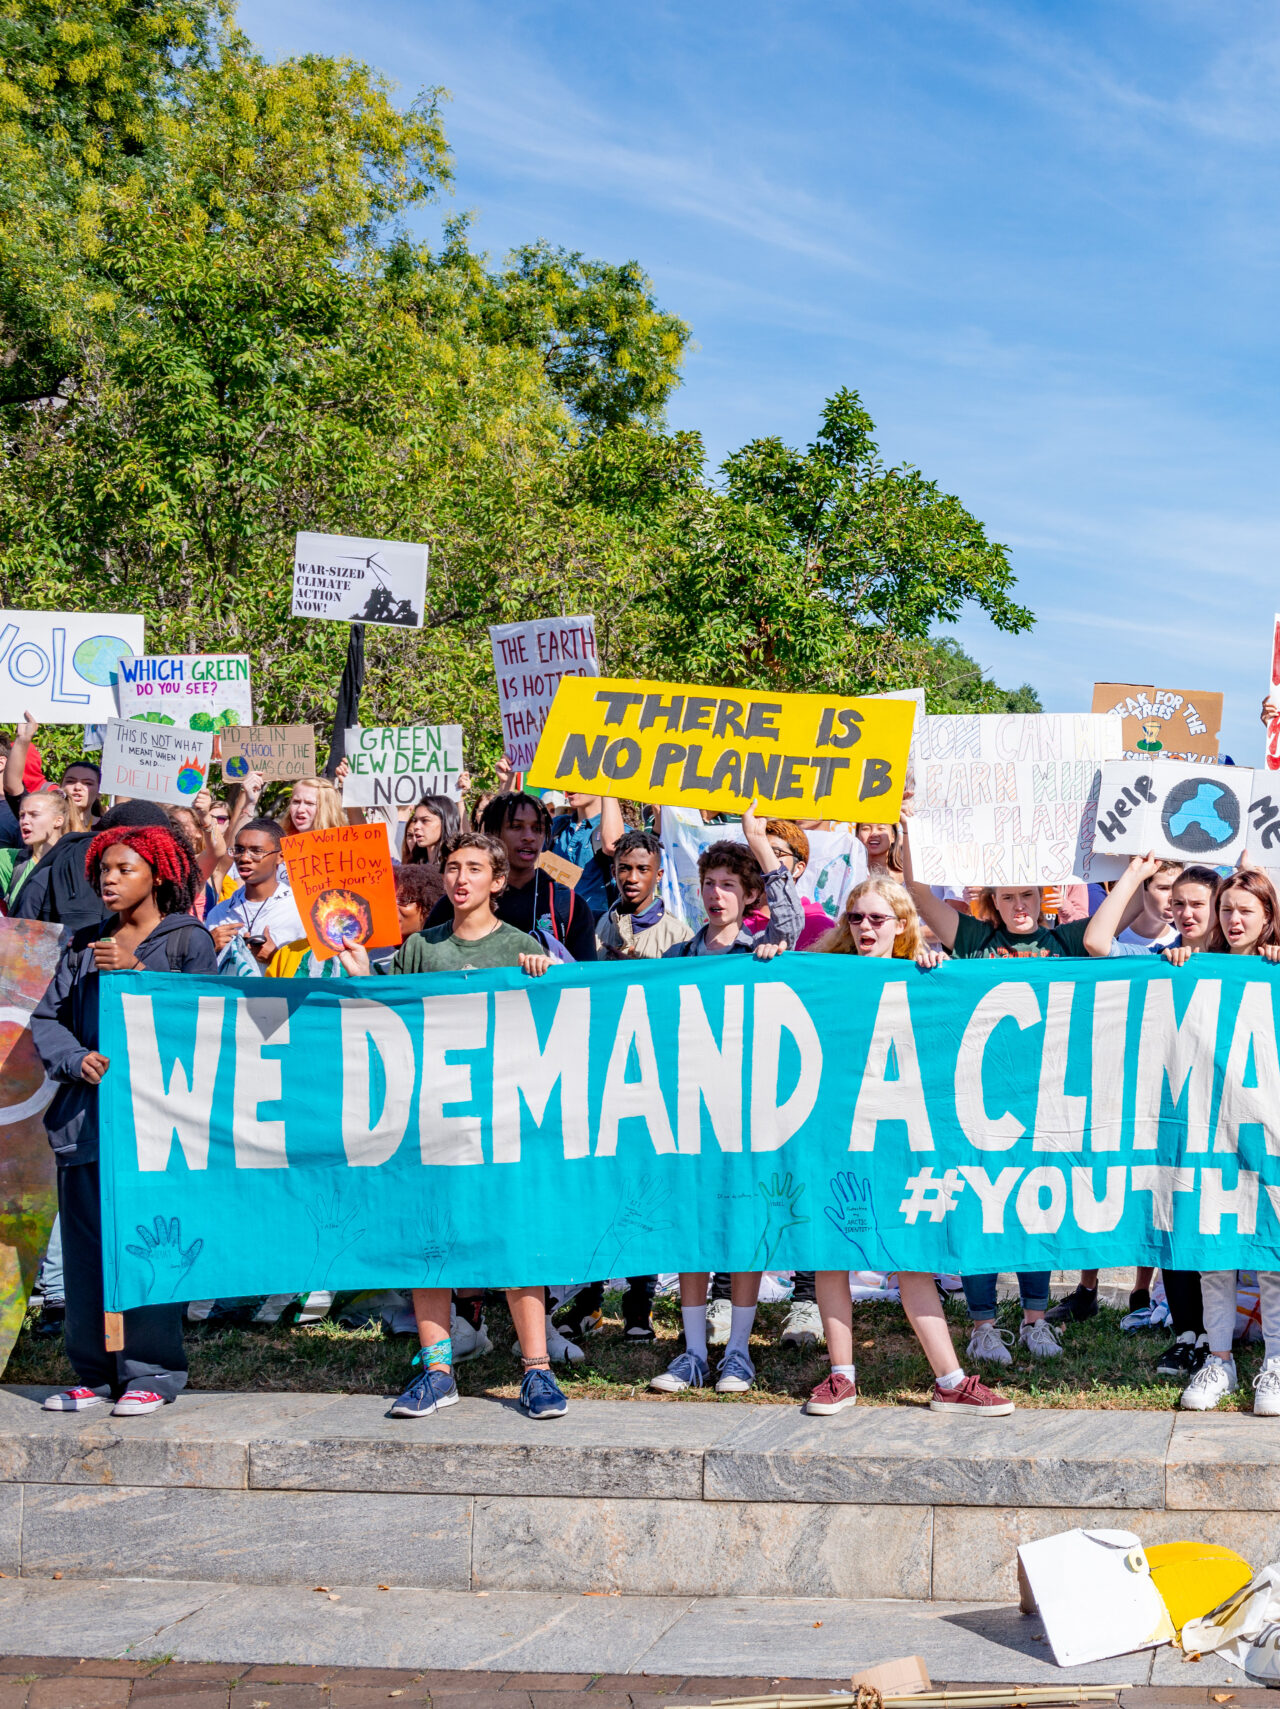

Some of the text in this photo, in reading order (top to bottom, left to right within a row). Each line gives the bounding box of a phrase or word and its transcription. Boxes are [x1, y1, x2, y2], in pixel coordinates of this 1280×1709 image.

[296, 576, 351, 591] CLIMATE
[297, 563, 365, 579] WAR-SIZED
[295, 588, 342, 602] ACTION
[295, 600, 327, 613] NOW!
[497, 627, 596, 665] THE EARTH
[120, 659, 248, 683] WHICH GREEN
[136, 681, 218, 696] DO YOU SEE?
[502, 674, 518, 699] IS
[594, 690, 782, 741] THERE
[816, 708, 865, 748] IS
[1131, 703, 1175, 720] TREES
[1155, 690, 1184, 710] FOR
[1182, 703, 1207, 736] THE
[114, 723, 204, 752] THIS IS NOT WHAT
[223, 727, 286, 742] I'D BE IN
[360, 726, 441, 751] GREEN
[995, 714, 1063, 761] CAN
[1073, 714, 1118, 759] WE
[128, 747, 153, 757] MEANT
[156, 751, 176, 761] WHEN
[240, 743, 310, 758] SCHOOL IF THE
[346, 750, 458, 774] NEW DEAL
[116, 765, 172, 793] DIE LIT
[251, 760, 309, 776] WAS COOL
[554, 733, 893, 804] NO PLANET B
[914, 805, 974, 844] THE
[284, 827, 382, 853] My World's on
[288, 852, 335, 882] FIRE
[121, 991, 291, 1172] WE
[338, 981, 823, 1168] DEMAND
[848, 981, 936, 1152] A
